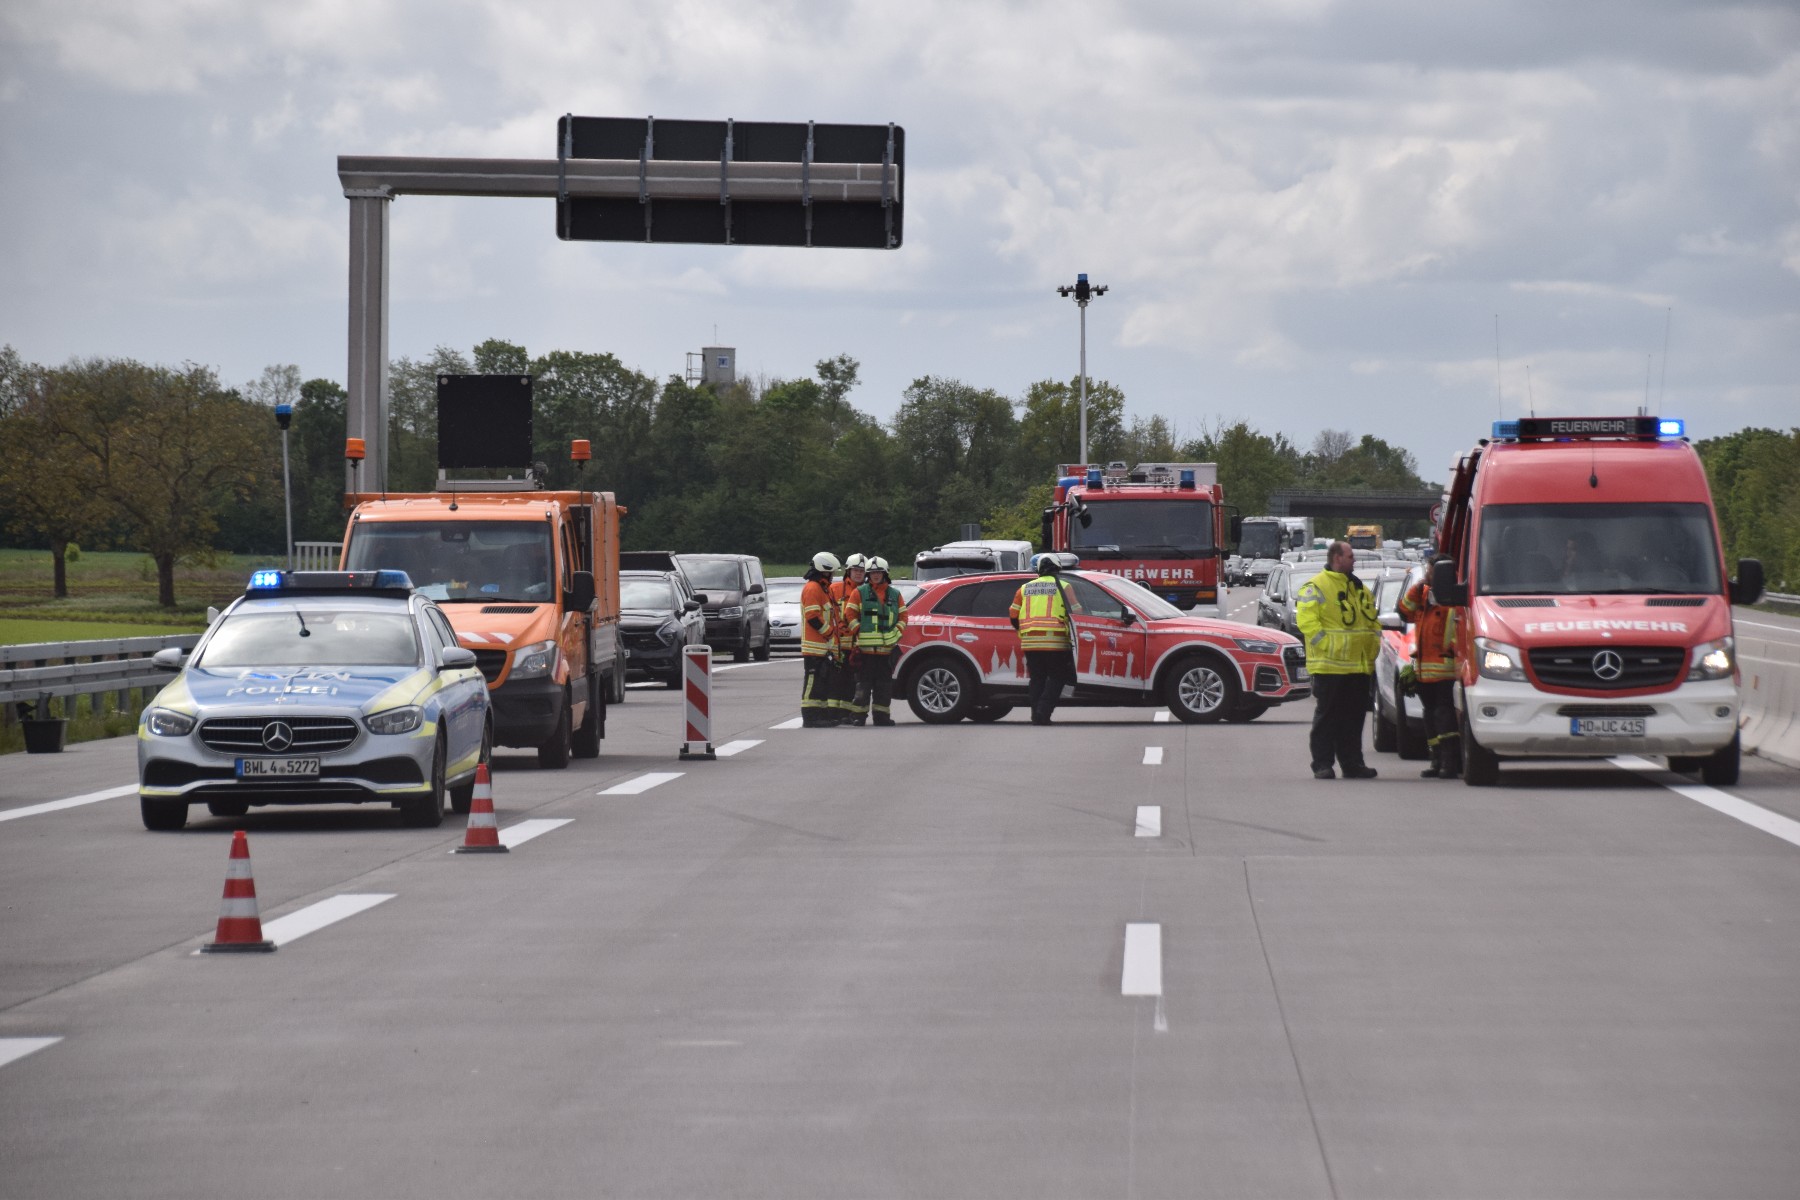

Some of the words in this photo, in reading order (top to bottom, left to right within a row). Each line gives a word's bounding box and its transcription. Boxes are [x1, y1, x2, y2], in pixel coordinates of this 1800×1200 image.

[1551, 420, 1625, 433] FEUERWEHR
[1090, 568, 1195, 579] UERWEHR
[1524, 619, 1689, 634] FEUERWEHR
[226, 685, 338, 697] POLIZEI
[1578, 720, 1594, 732] HD
[1602, 721, 1618, 733] UC
[1620, 721, 1644, 733] 415
[244, 761, 267, 774] BWL
[287, 760, 318, 774] 5272
